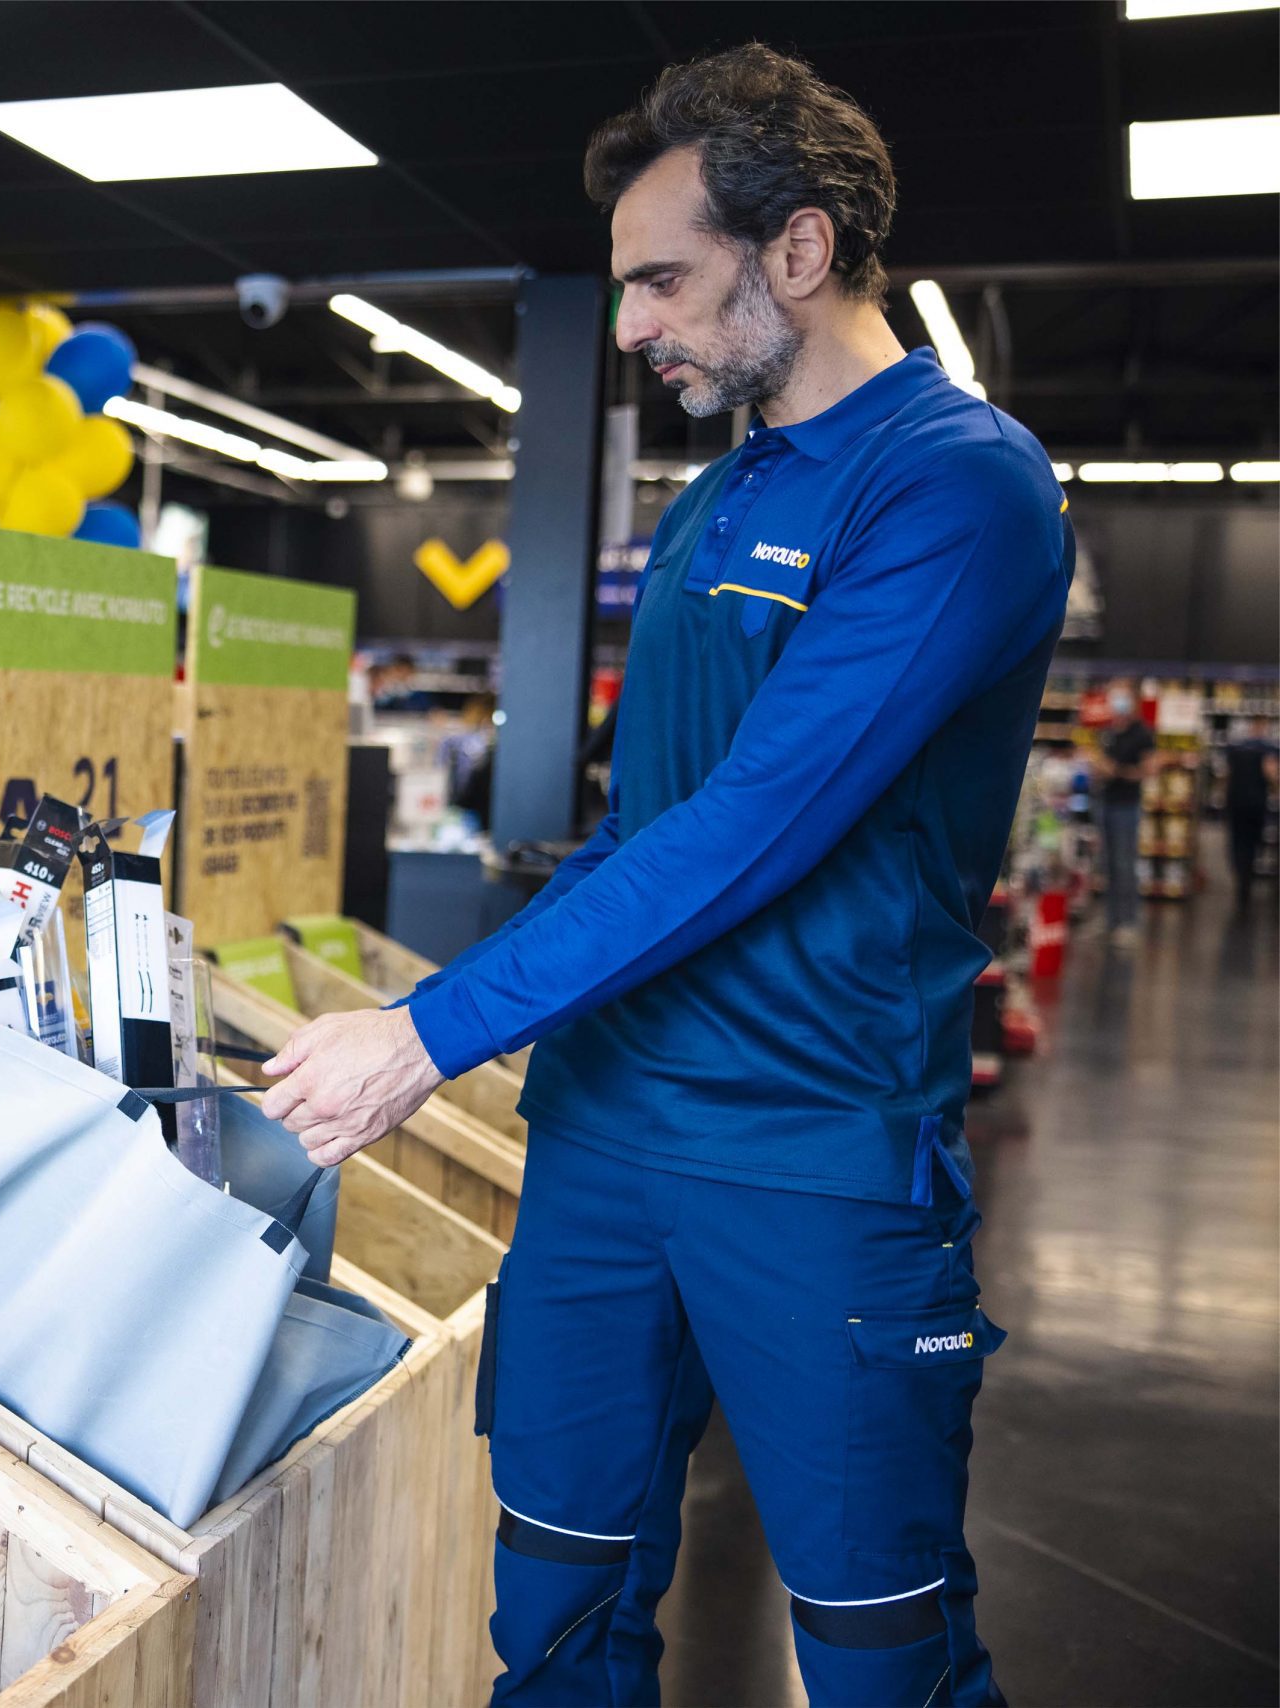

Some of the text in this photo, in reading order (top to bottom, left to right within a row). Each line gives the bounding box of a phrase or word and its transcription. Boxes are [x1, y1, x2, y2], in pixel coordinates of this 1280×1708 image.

[750, 541, 810, 569] Norauto
[6, 583, 70, 616] RECYCLE
[914, 1331, 974, 1354] Norauto
